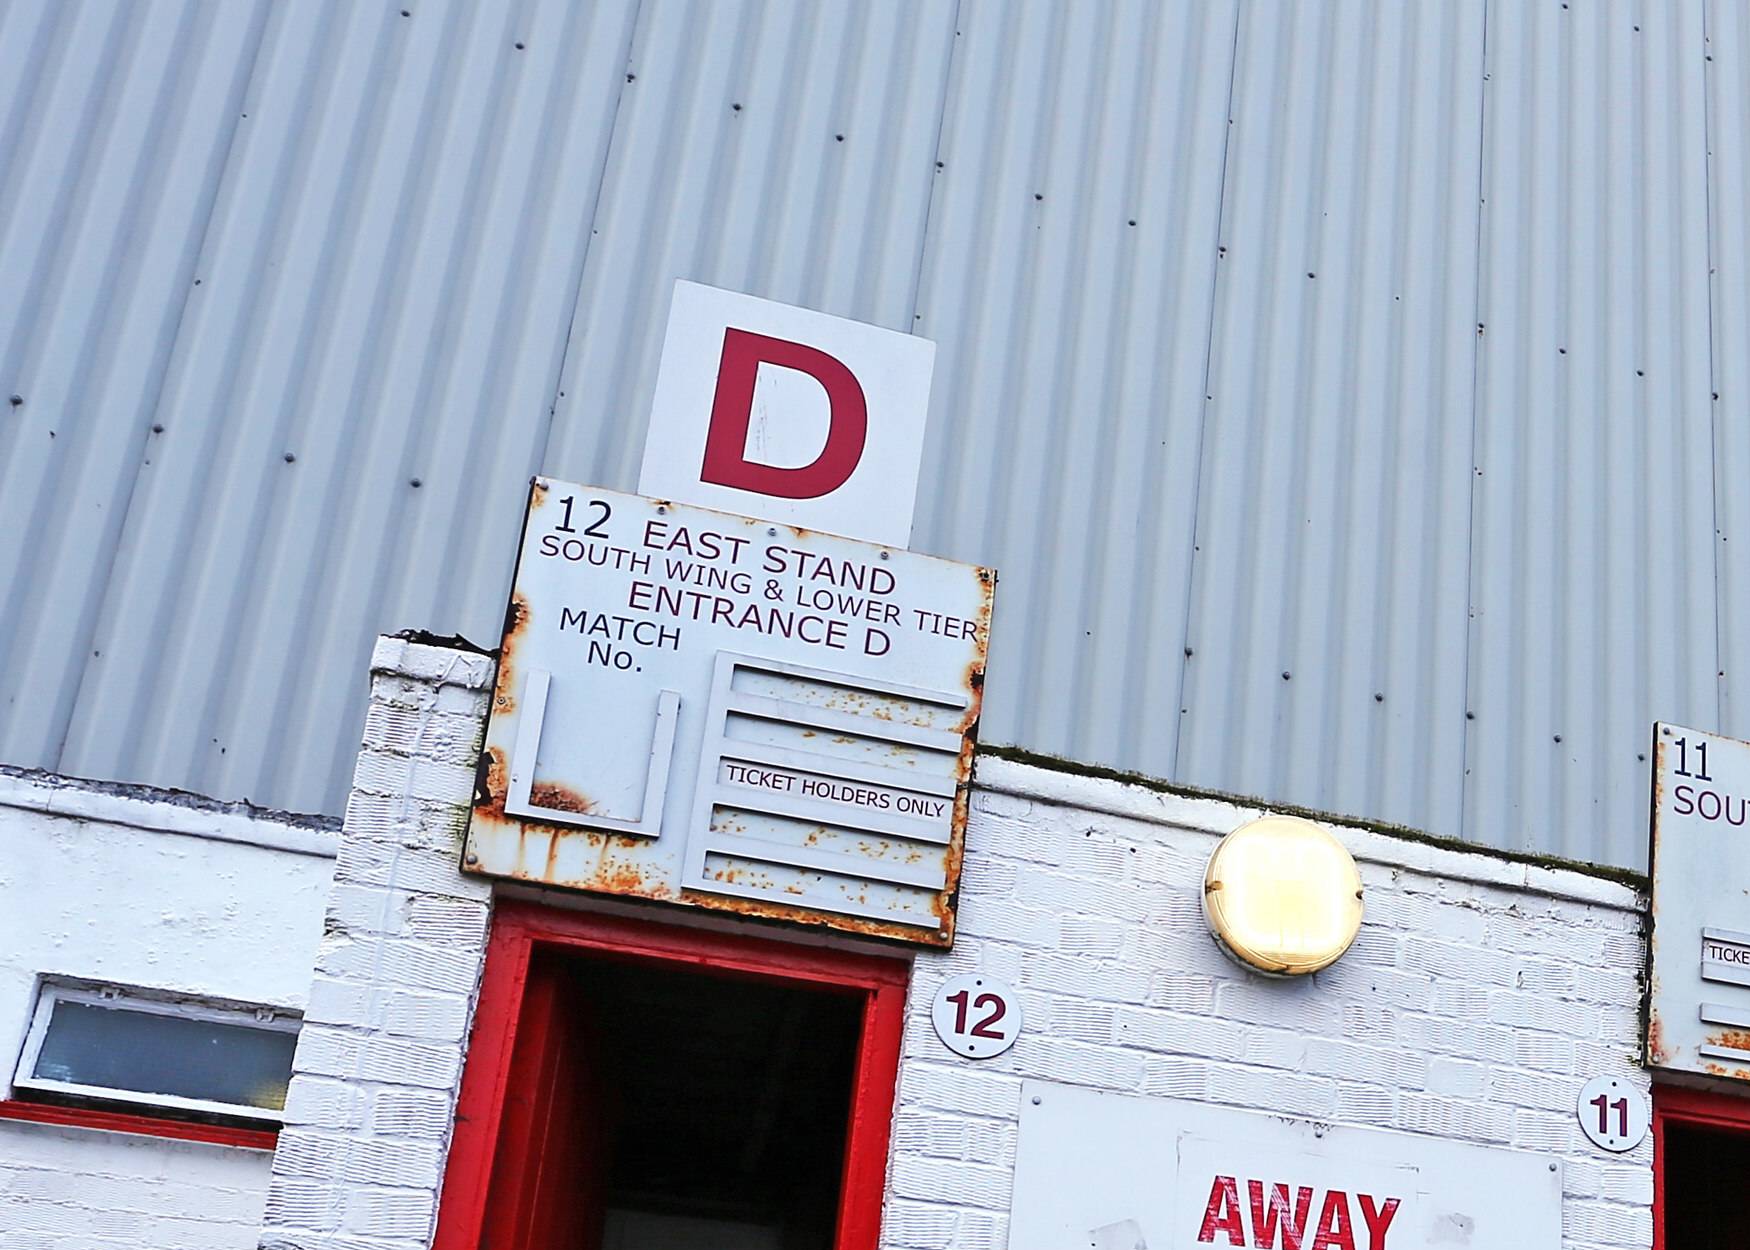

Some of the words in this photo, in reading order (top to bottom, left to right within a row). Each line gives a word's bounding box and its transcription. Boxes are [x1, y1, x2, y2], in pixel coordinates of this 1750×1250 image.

[699, 326, 868, 499] D
[553, 496, 613, 539] 12
[642, 520, 749, 565] EAST
[763, 545, 896, 596] STAND
[538, 534, 651, 576] SOUTH
[665, 562, 752, 596] WING
[763, 578, 785, 602] &
[797, 584, 901, 626] LOWER
[914, 611, 979, 643] TIER
[559, 608, 681, 651] MATCH
[628, 581, 848, 650] ENTRANCE
[864, 629, 891, 657] D
[587, 642, 643, 674] No.
[1673, 737, 1713, 782] 11
[727, 764, 796, 792] TICKET
[801, 776, 890, 810] HOLDERS
[896, 792, 944, 818] ONLY
[946, 992, 1004, 1040] 12
[1590, 1094, 1628, 1138] 11
